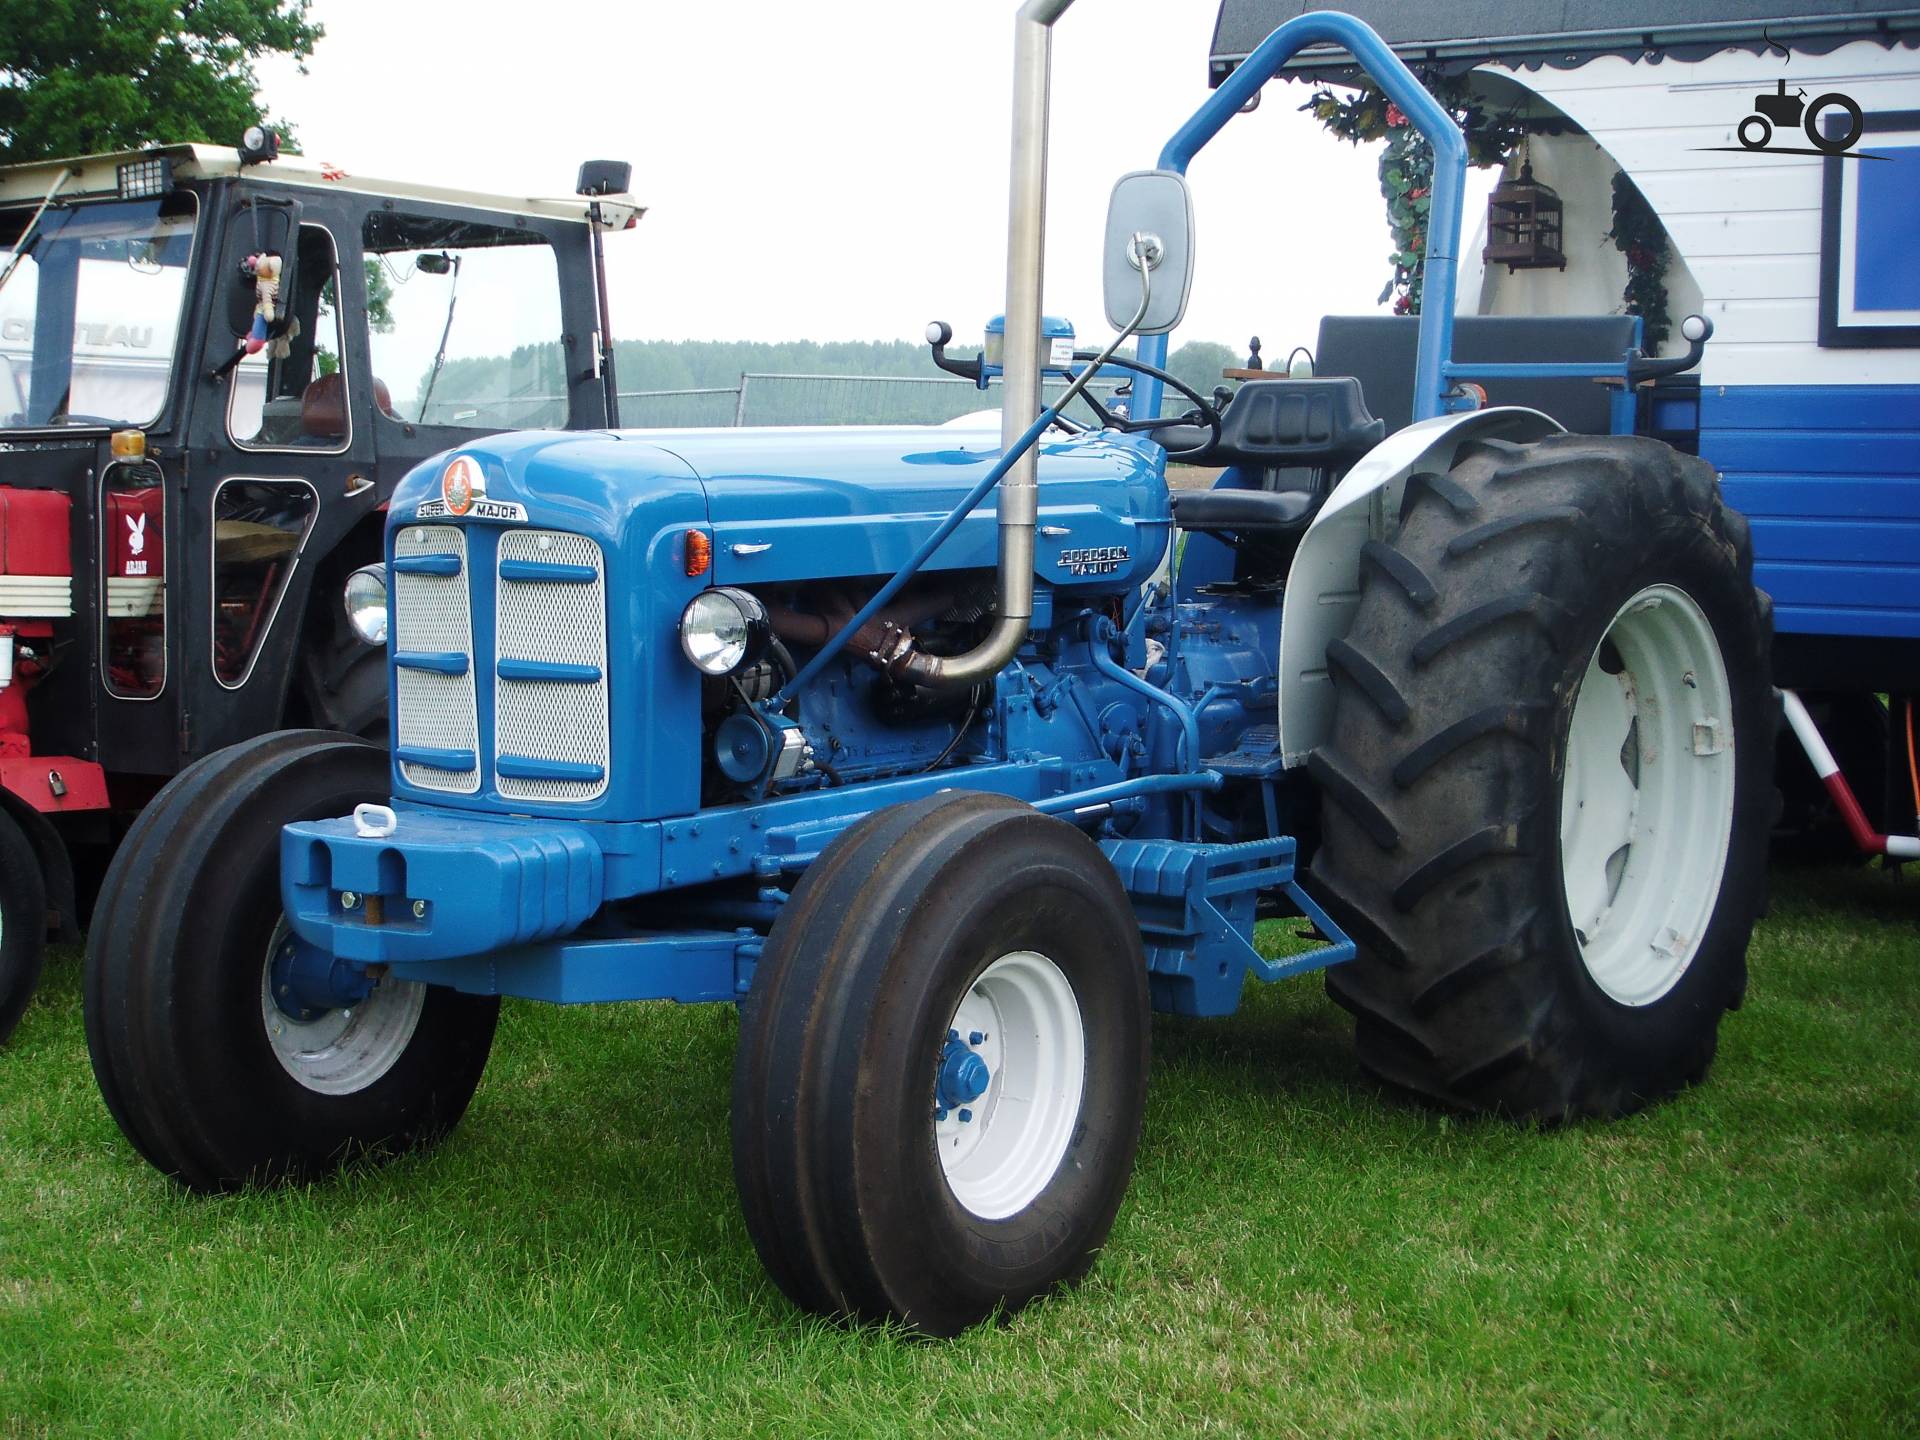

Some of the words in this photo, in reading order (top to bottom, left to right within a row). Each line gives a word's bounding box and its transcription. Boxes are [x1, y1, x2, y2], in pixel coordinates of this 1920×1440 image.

[2, 317, 153, 349] CTEAU
[420, 504, 445, 516] SUPER
[476, 505, 517, 519] MAJOR
[1060, 546, 1128, 562] FORDSON
[1070, 562, 1118, 576] MAJOR
